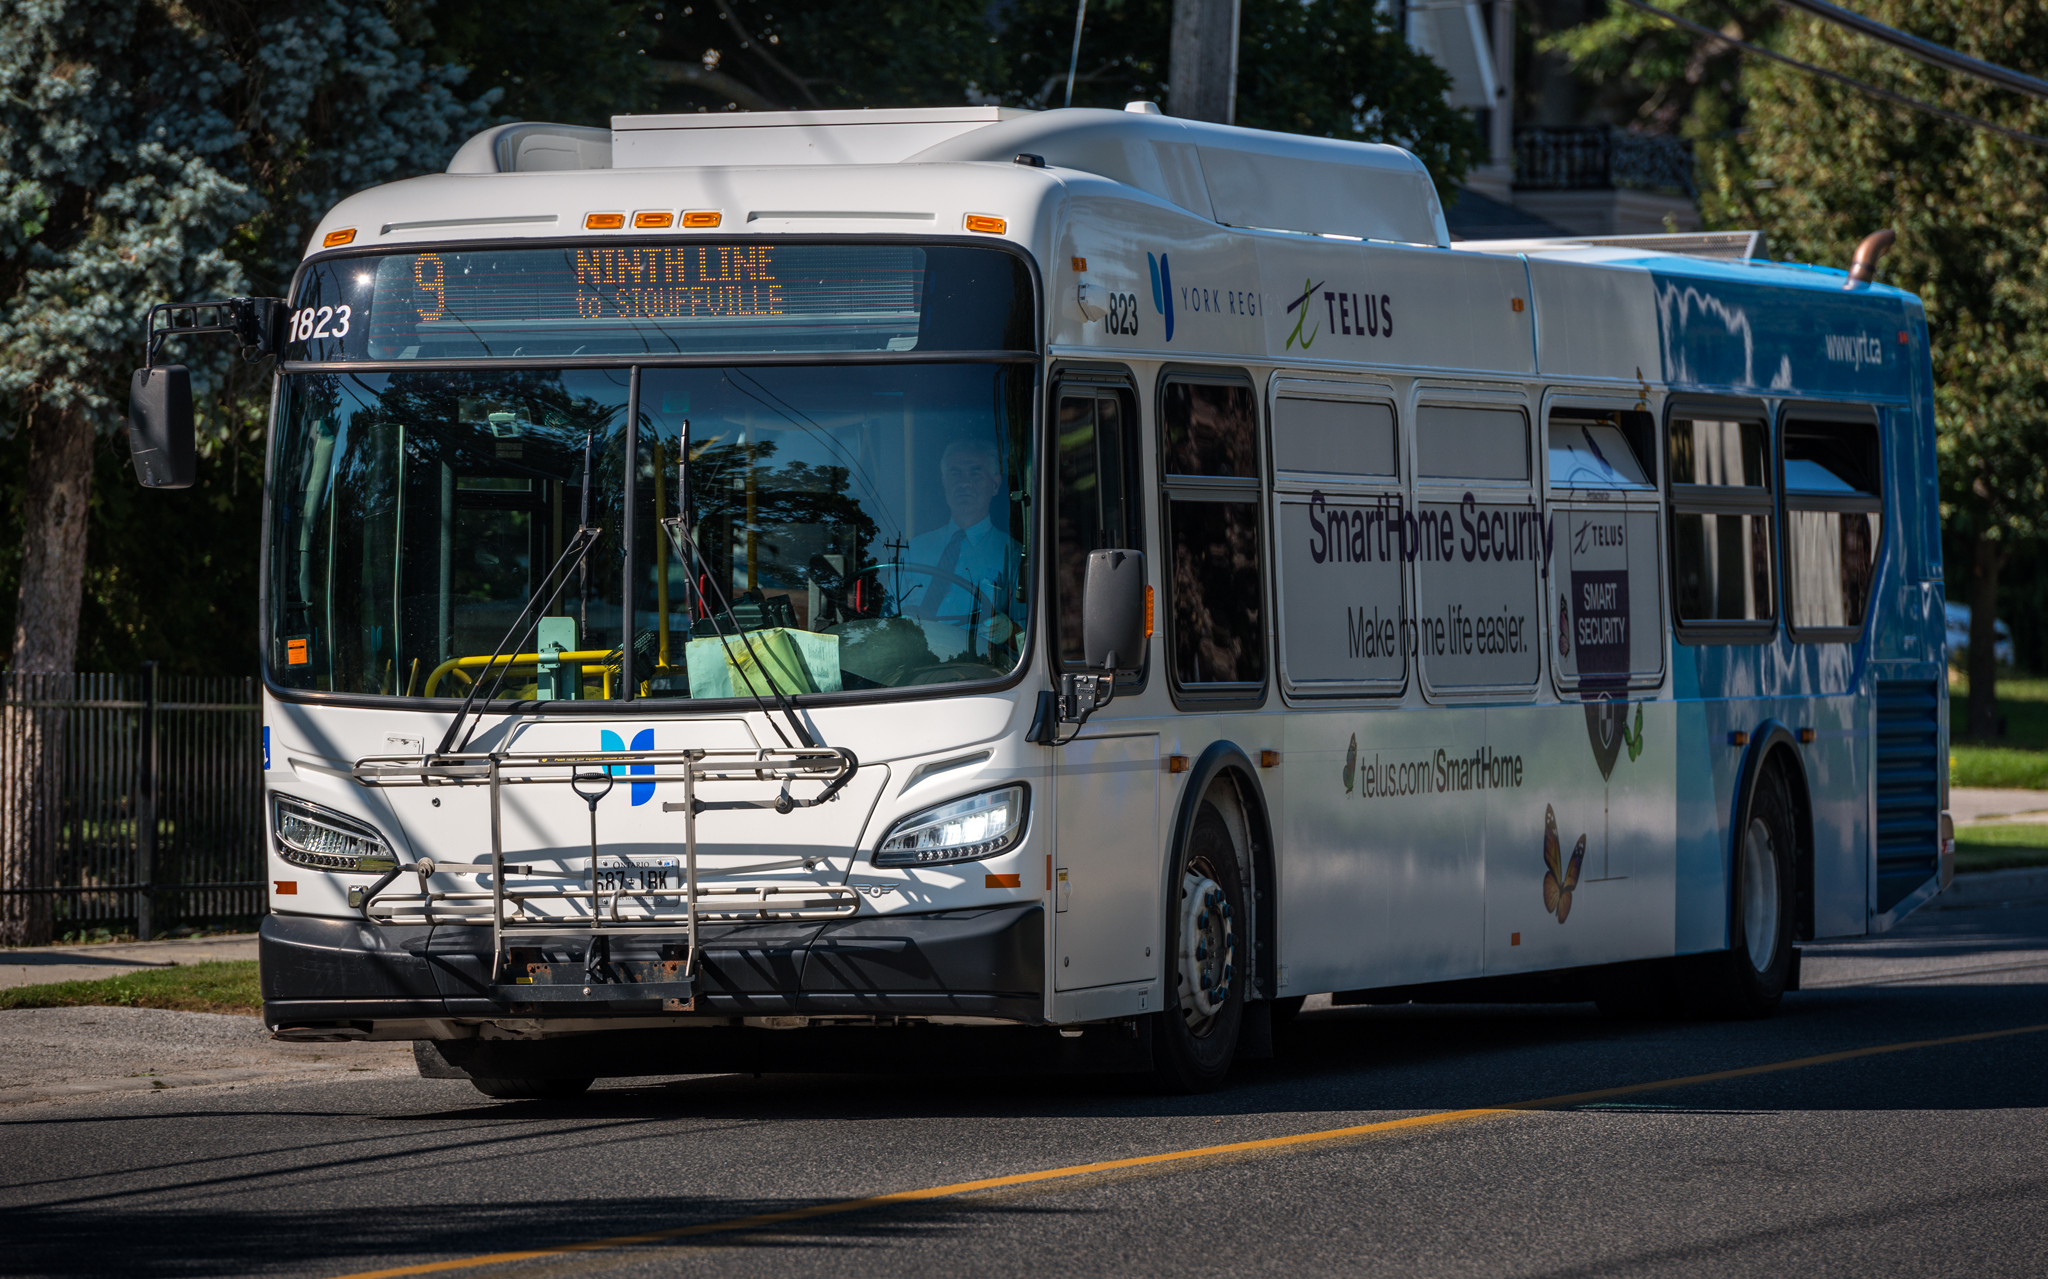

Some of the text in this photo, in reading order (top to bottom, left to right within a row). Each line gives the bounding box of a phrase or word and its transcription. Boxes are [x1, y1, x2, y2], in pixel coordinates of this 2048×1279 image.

[577, 246, 775, 283] NINTH LINE
[414, 253, 445, 321] 9
[576, 285, 783, 318] to STOUFFVILLE
[1181, 286, 1221, 314] YORK
[289, 304, 352, 343] 1823
[1324, 291, 1393, 338] TELUS
[1825, 330, 1882, 372] www.yrt.ca
[1309, 489, 1554, 579] SmartHome Security
[1592, 525, 1624, 547] TELUS
[1583, 582, 1617, 611] SMART
[1348, 604, 1528, 659] Make home life easier.
[1578, 617, 1625, 646] SECURITY
[1361, 746, 1523, 799] telus.com/SmartHome
